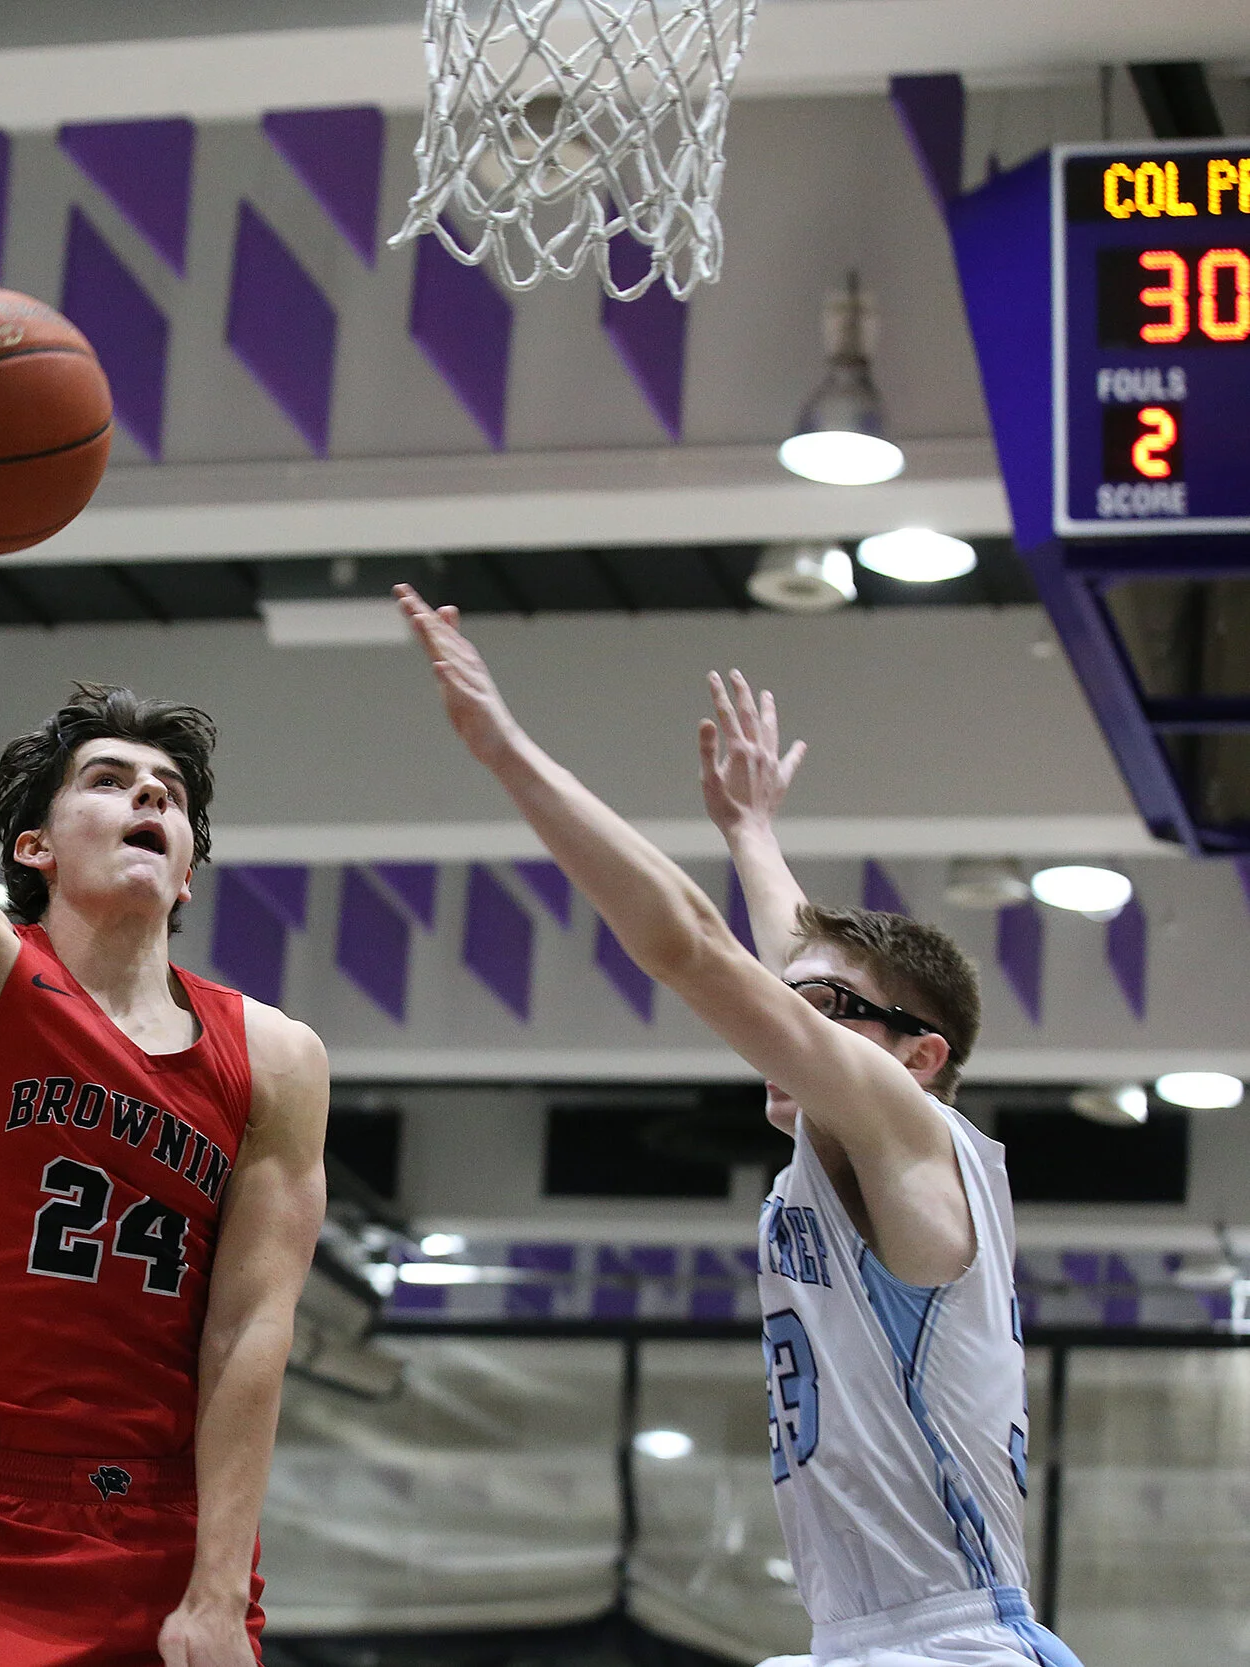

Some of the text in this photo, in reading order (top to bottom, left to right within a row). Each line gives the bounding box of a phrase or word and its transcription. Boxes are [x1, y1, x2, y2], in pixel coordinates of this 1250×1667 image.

[1103, 160, 1198, 220] COL
[1138, 248, 1250, 344] 30
[1096, 366, 1188, 402] FOULS
[1131, 406, 1178, 479] 2
[1096, 481, 1188, 517] SCORE
[4, 1076, 233, 1204] BROWNIN
[27, 1155, 189, 1298] 24
